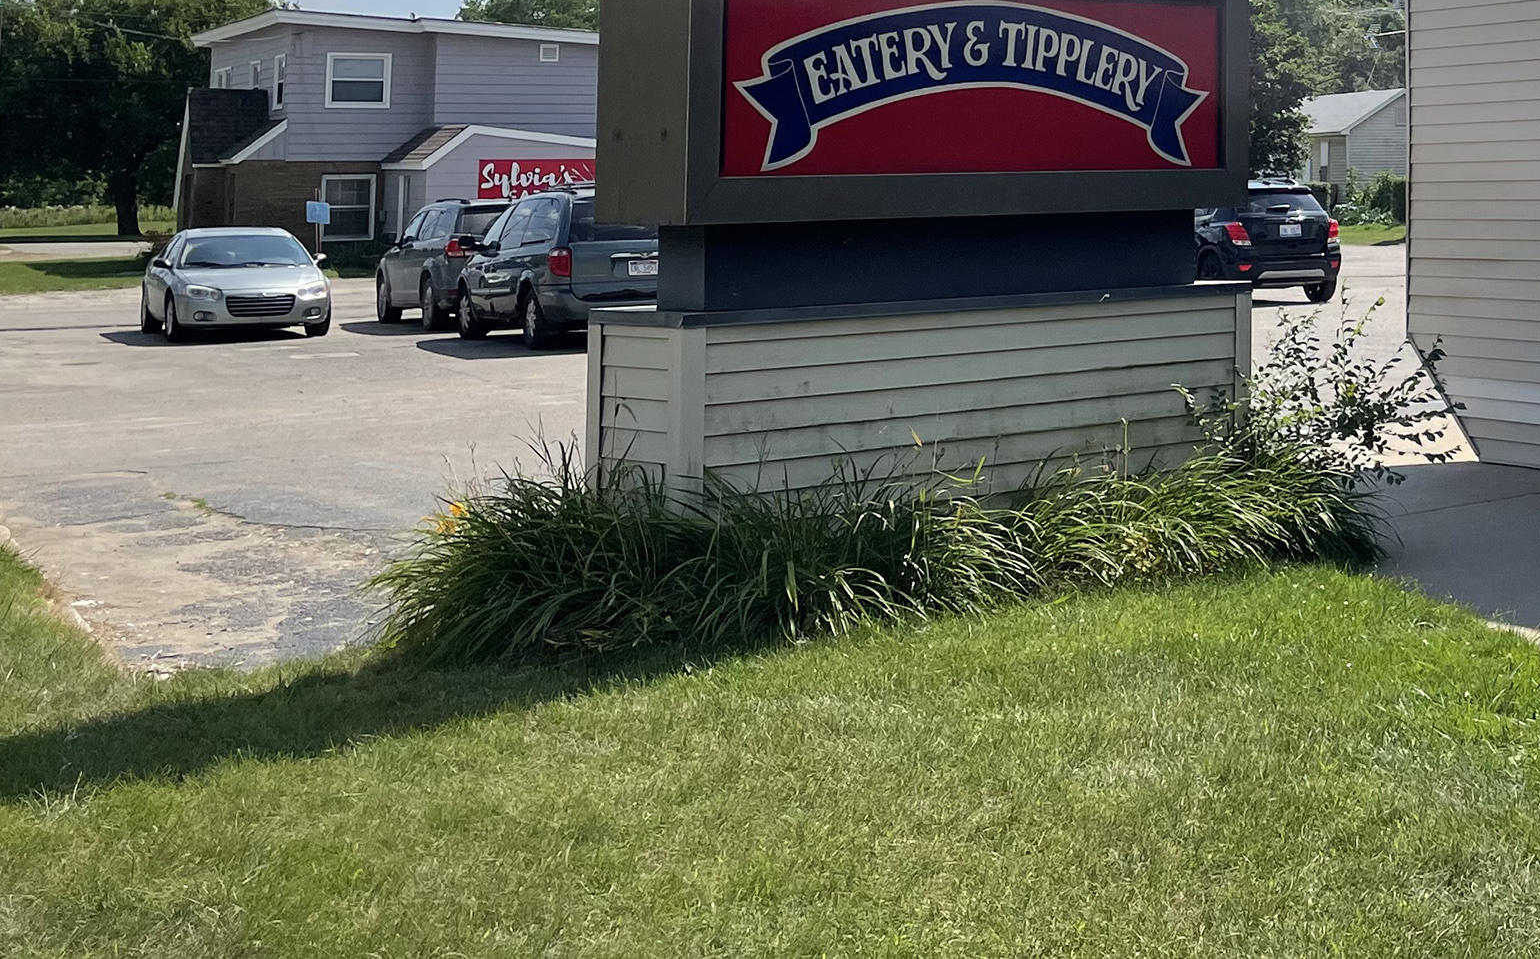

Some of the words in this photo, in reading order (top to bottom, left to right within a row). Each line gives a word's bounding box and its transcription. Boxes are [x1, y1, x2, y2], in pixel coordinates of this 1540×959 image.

[803, 22, 957, 104] EATERY
[963, 20, 990, 65] &
[998, 20, 1163, 111] TIPPLERY
[480, 162, 574, 197] Sylvia's
